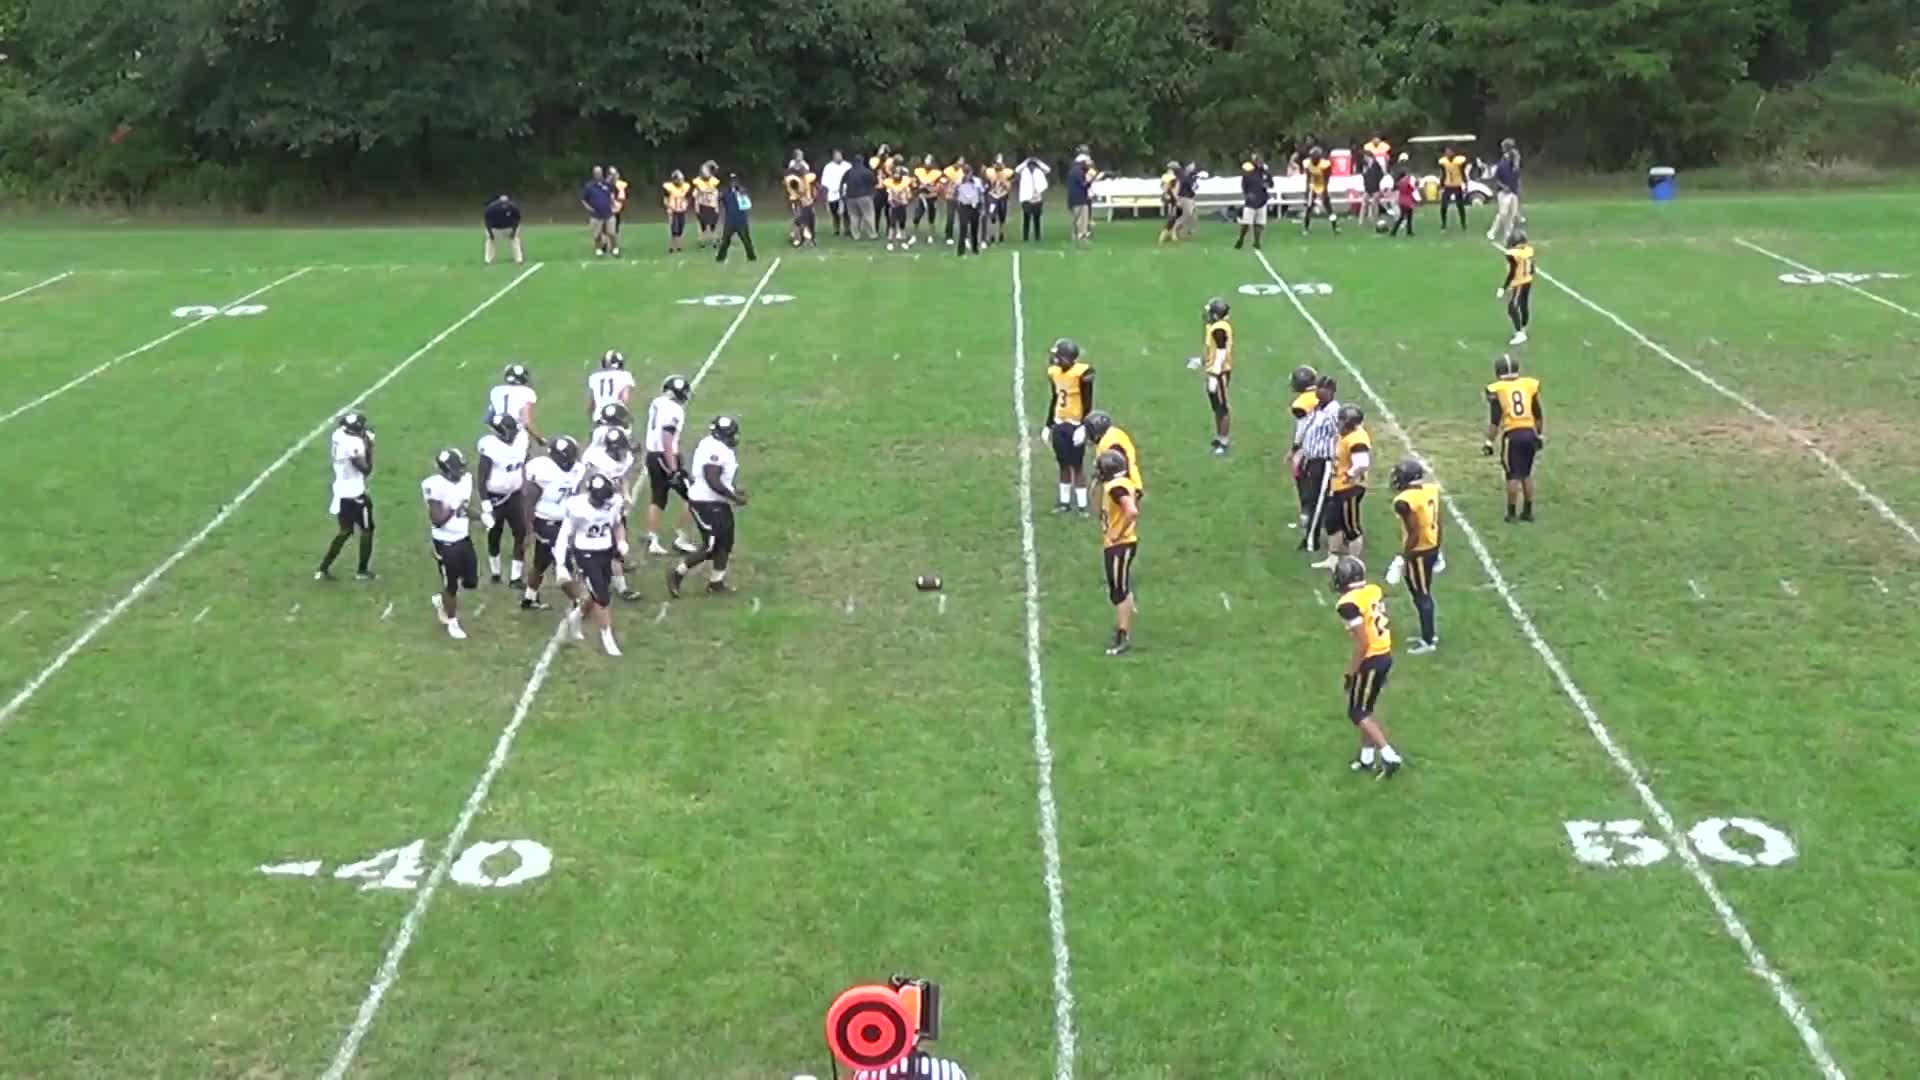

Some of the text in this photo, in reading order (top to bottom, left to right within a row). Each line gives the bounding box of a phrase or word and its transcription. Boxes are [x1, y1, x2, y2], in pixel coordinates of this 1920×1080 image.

[600, 378, 614, 398] 11
[1058, 388, 1069, 409] 3
[1511, 390, 1525, 417] 8
[1564, 817, 1799, 867] 50
[333, 838, 553, 891] 40
